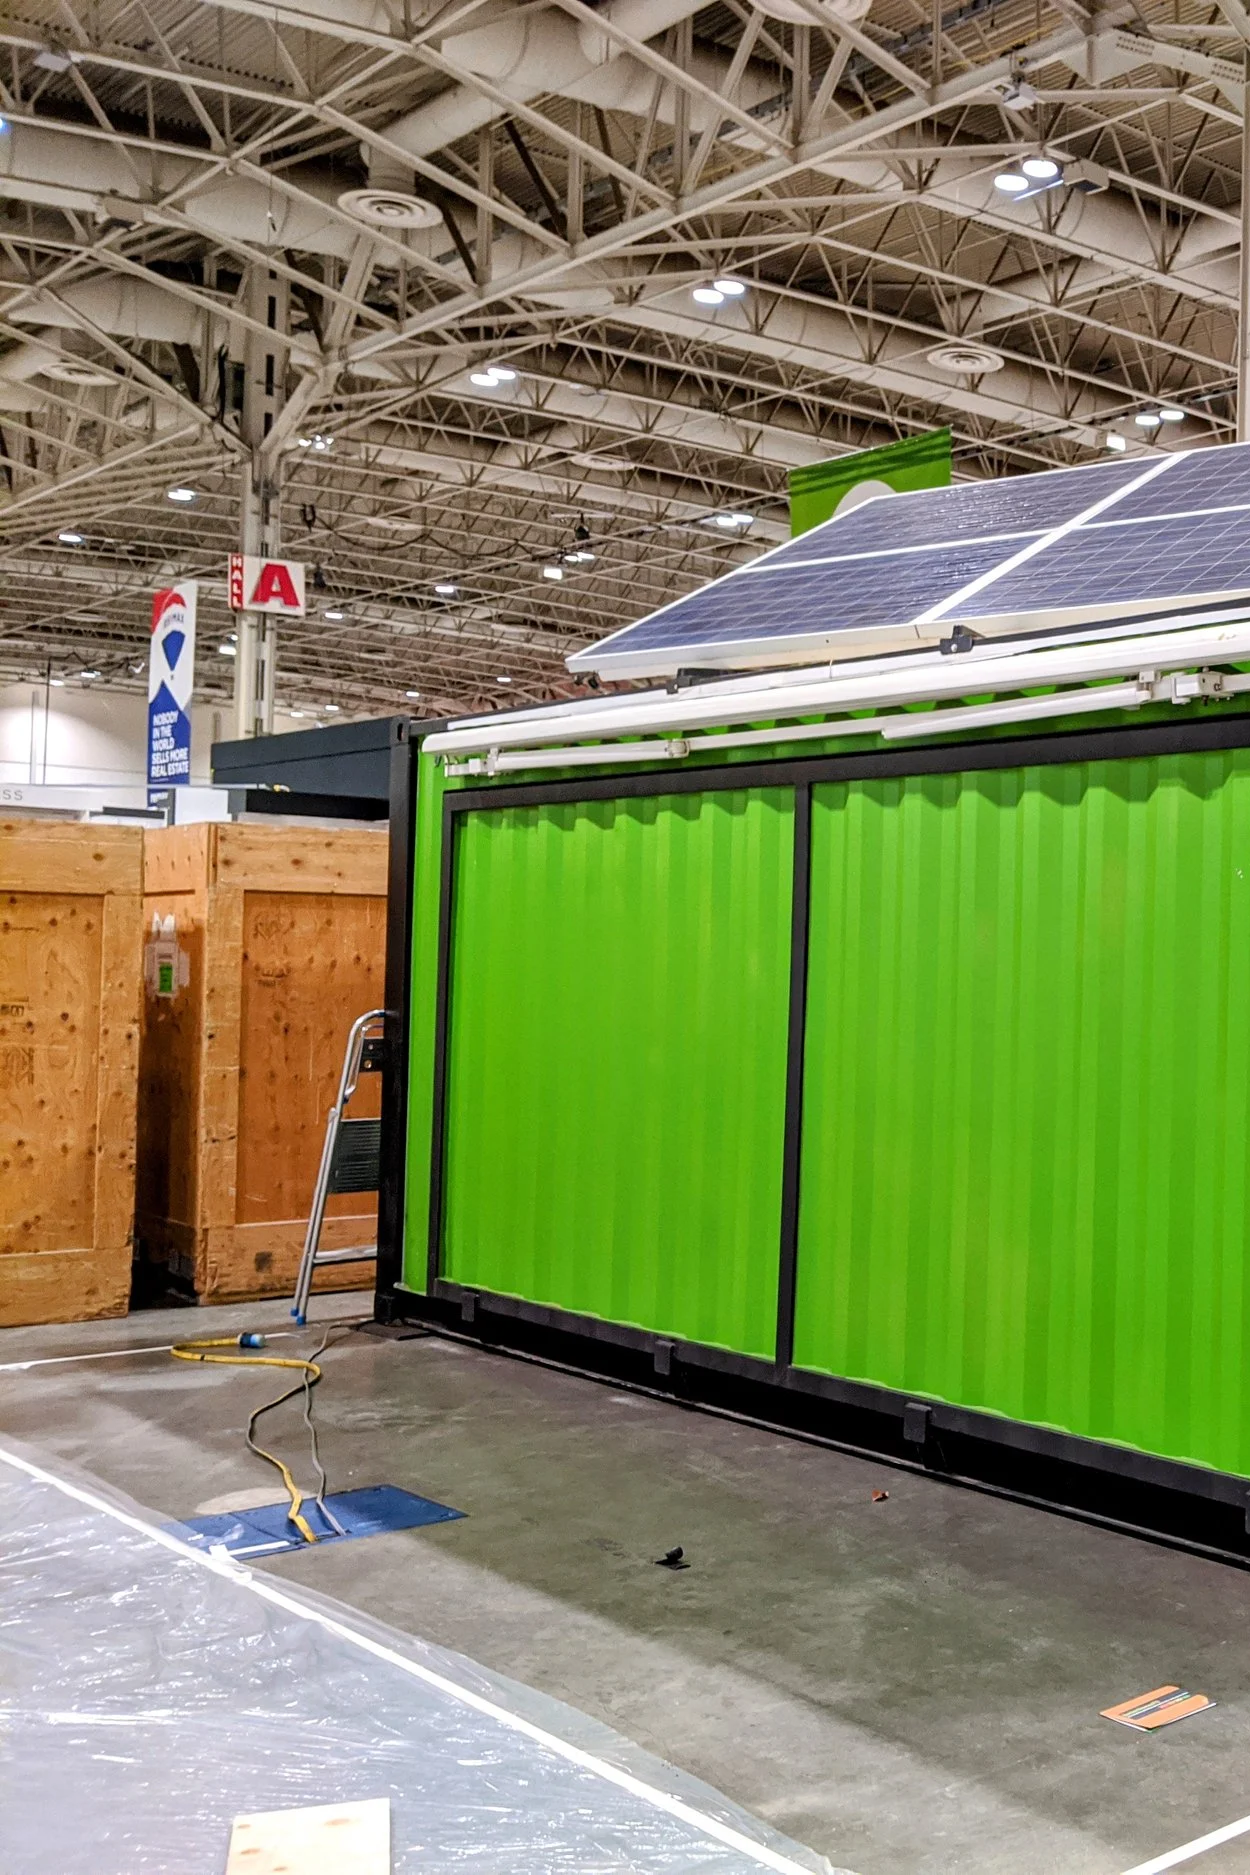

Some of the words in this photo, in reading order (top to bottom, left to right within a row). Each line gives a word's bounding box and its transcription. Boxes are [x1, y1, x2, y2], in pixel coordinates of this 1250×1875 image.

[232, 556, 242, 608] HALL
[250, 562, 300, 608] A
[151, 751, 169, 765] SELLS
[169, 747, 188, 762] MORE
[151, 763, 168, 778] REAL
[167, 761, 189, 776] ESTATE
